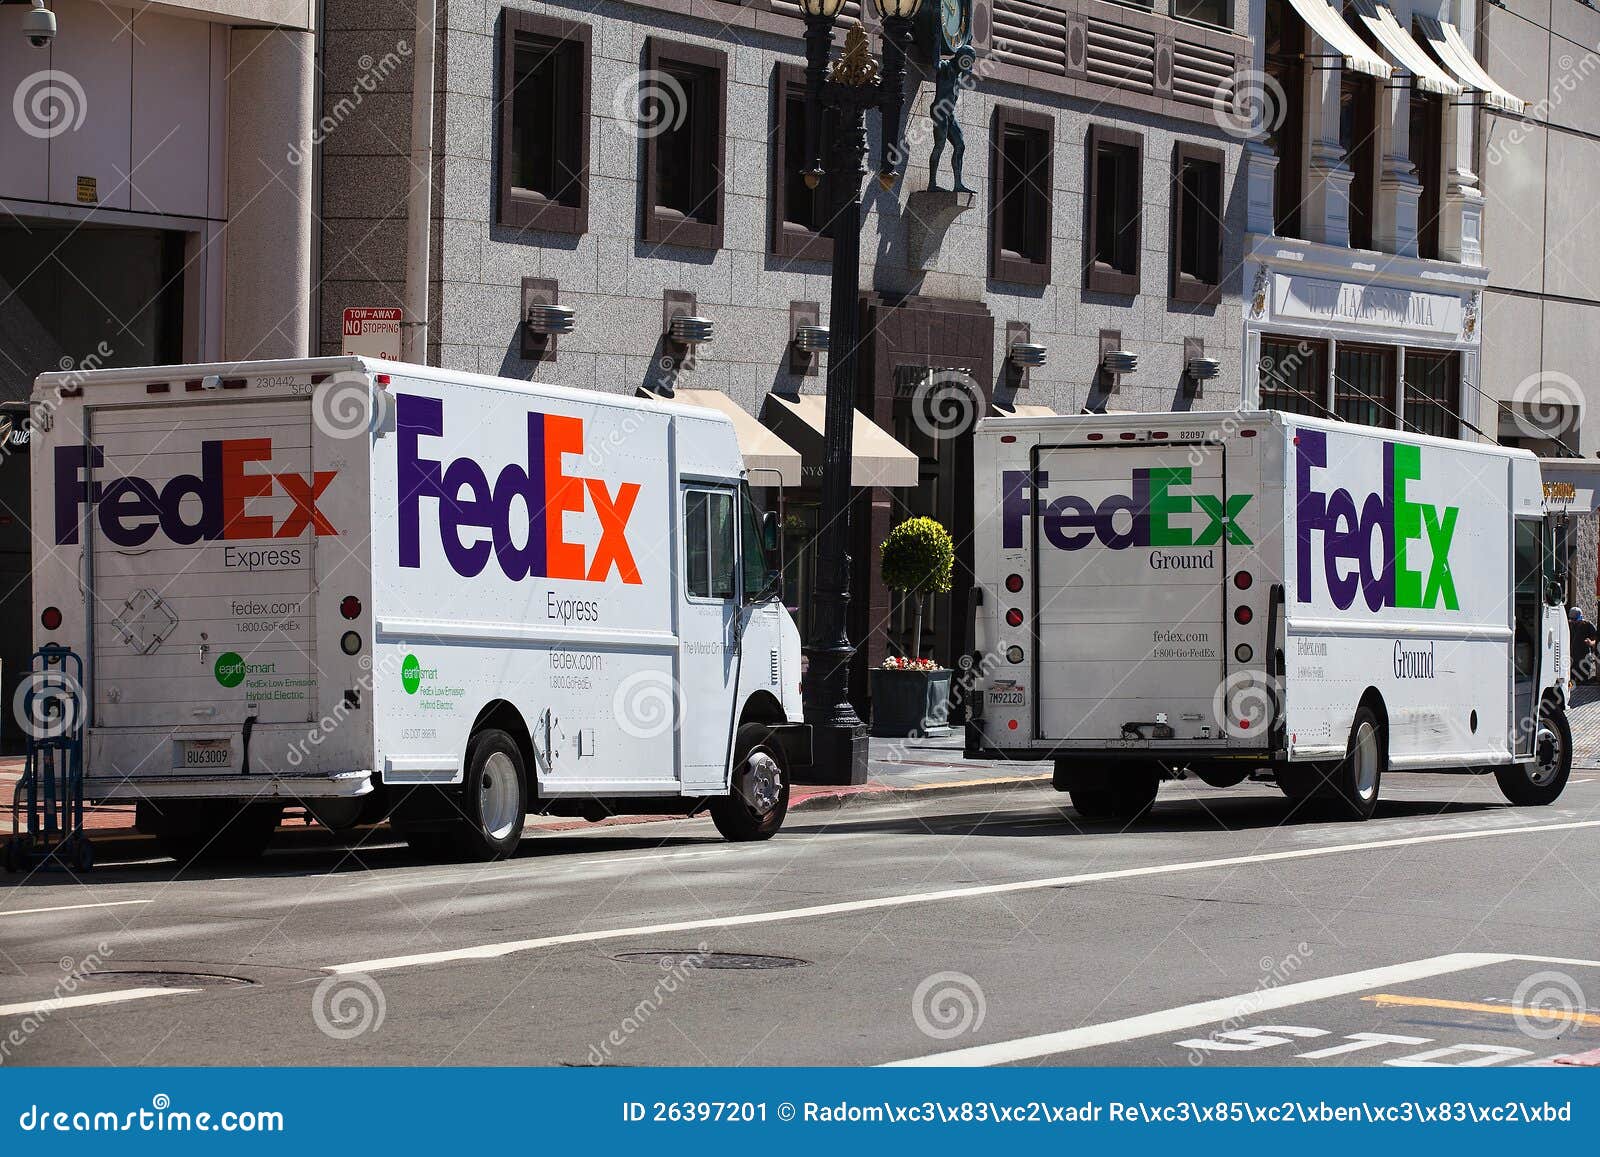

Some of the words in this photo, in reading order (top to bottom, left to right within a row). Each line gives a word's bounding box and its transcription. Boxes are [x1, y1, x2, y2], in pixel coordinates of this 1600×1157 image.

[350, 310, 395, 319] TOW-AWAY
[346, 320, 360, 334] NO
[363, 323, 399, 334] STOPPING
[256, 375, 296, 389] 230442
[292, 384, 313, 395] SFO
[1180, 430, 1205, 440] 82097
[54, 437, 339, 547] FedEx
[396, 393, 643, 585] FedEx
[1002, 467, 1254, 551] FedEx
[1295, 428, 1460, 613] FedEx
[224, 546, 301, 572] Express
[1150, 550, 1214, 570] Ground
[232, 601, 301, 616] fedex.com
[547, 591, 599, 626] Express
[1153, 630, 1209, 642] fedex.com
[549, 646, 602, 671] fedex.com
[1393, 639, 1434, 680] Ground
[187, 750, 228, 763] 8U63009
[1173, 1025, 1560, 1067] STO
